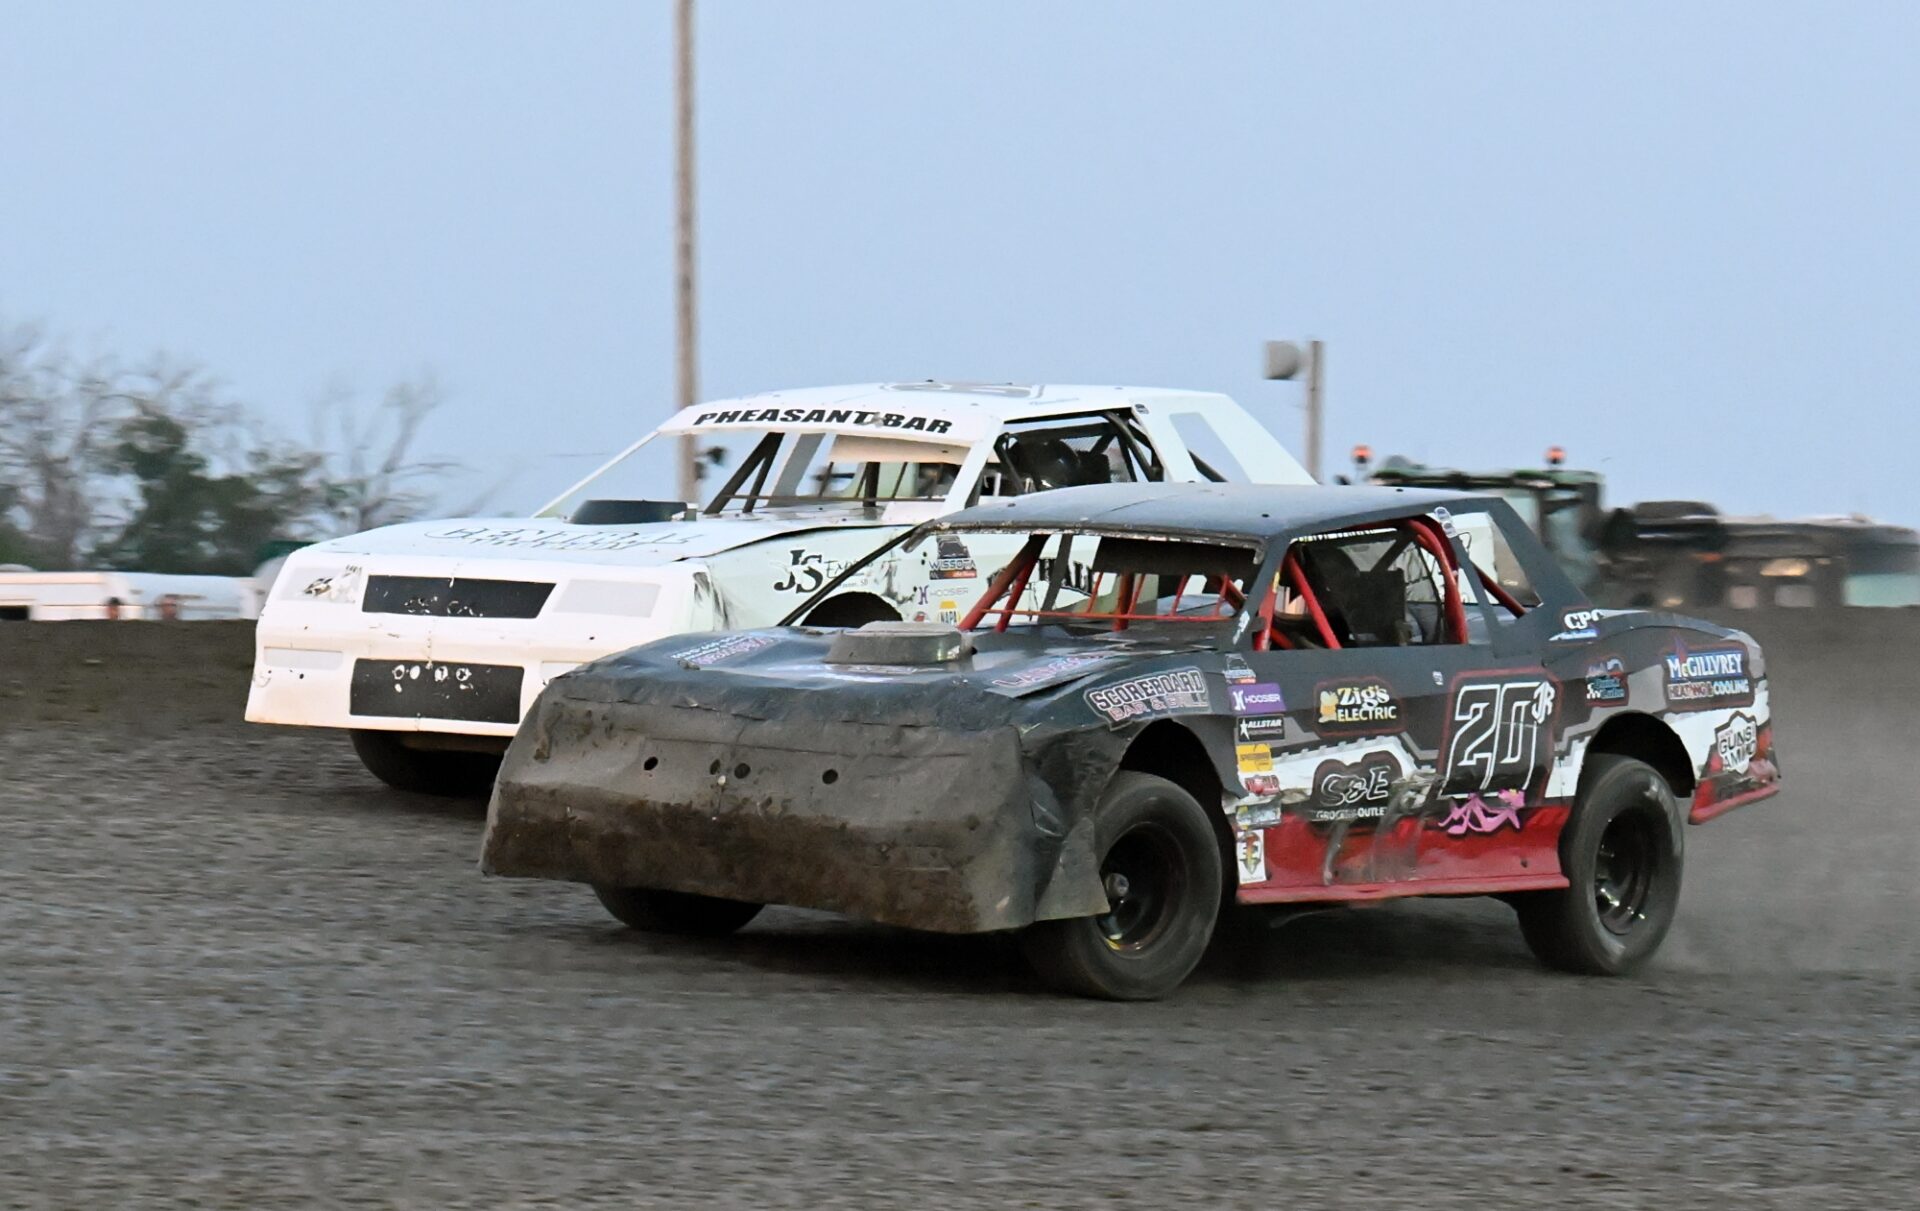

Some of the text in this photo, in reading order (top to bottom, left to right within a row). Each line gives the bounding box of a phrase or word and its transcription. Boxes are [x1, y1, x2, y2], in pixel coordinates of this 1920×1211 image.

[693, 408, 953, 434] PHEASANT BAR
[774, 549, 823, 594] JS
[929, 560, 976, 571] WISSOTA
[940, 610, 957, 625] NAPA
[1089, 670, 1205, 711] SCOREBOARD
[1713, 679, 1750, 695] COOLING
[1244, 692, 1281, 704] HOOSIER
[1108, 700, 1150, 721] BAR
[1337, 705, 1398, 723] ELECTRIC
[1247, 718, 1283, 730] ALLSTAR
[1719, 726, 1752, 755] GUNS
